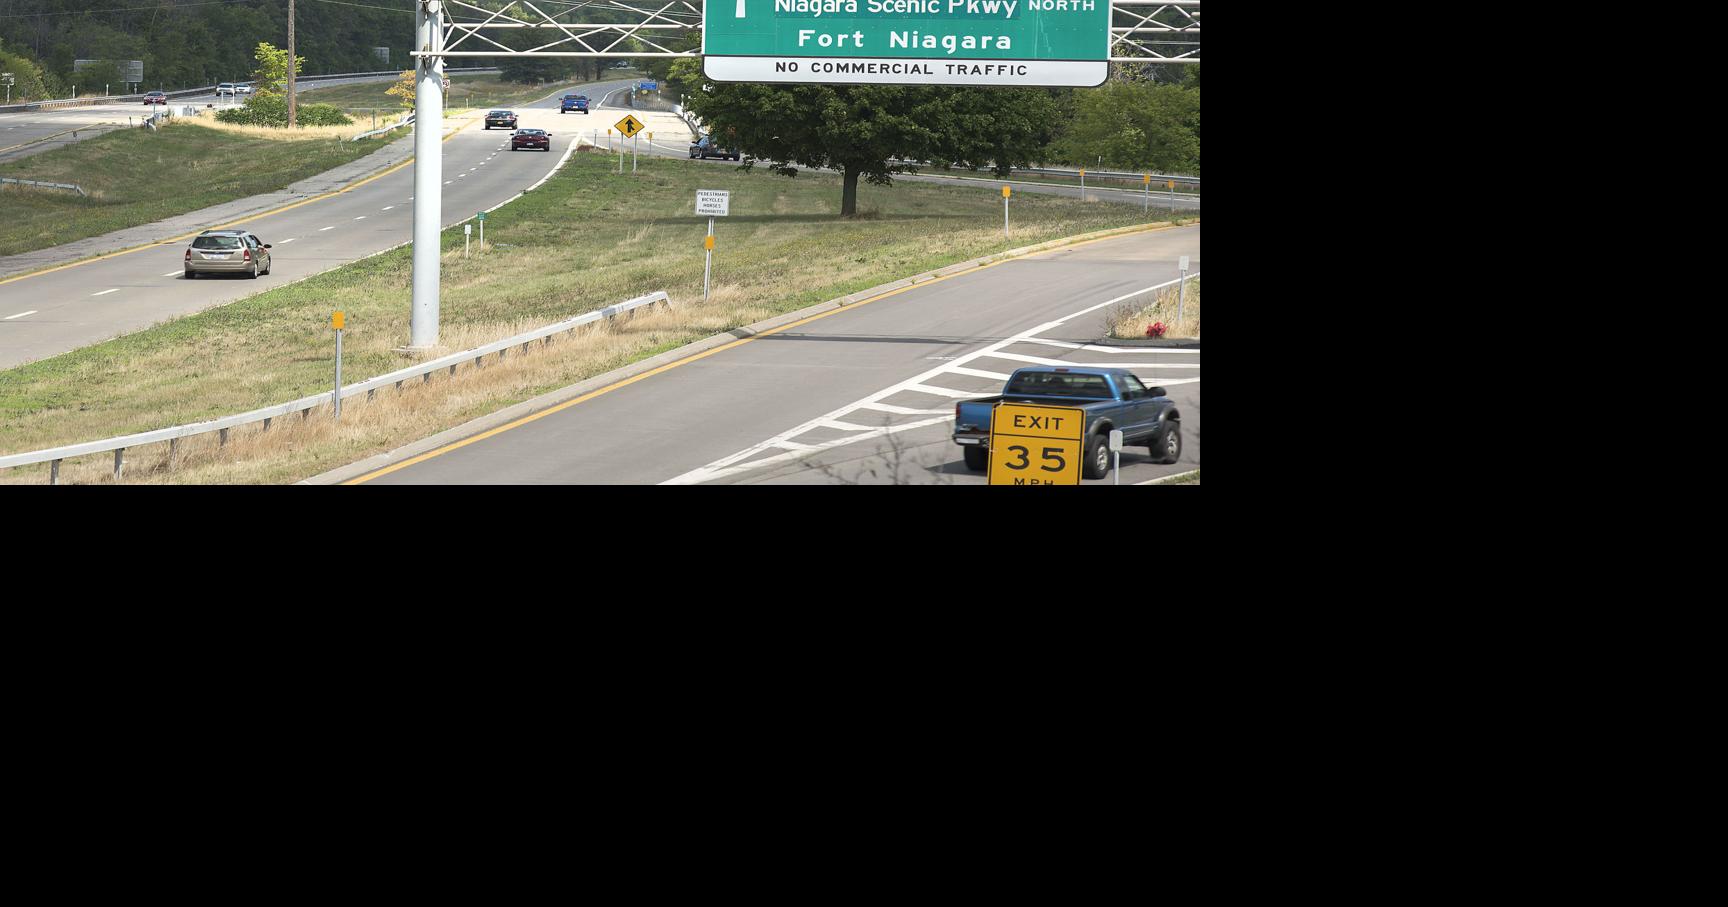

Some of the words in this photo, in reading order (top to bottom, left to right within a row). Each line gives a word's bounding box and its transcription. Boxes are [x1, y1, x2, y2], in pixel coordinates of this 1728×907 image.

[775, 0, 858, 17] Niagara
[867, 0, 940, 13] Scenic
[948, 0, 1018, 18] Pkwy
[1028, 0, 1095, 11] NORTH
[798, 29, 865, 48] Fort
[889, 31, 1011, 54] Niagara
[775, 62, 799, 73] NO
[811, 62, 934, 75] COMMERCIAL
[945, 64, 1028, 76] TRAFFIC
[1014, 415, 1064, 430] EXIT
[1004, 445, 1066, 473] 35
